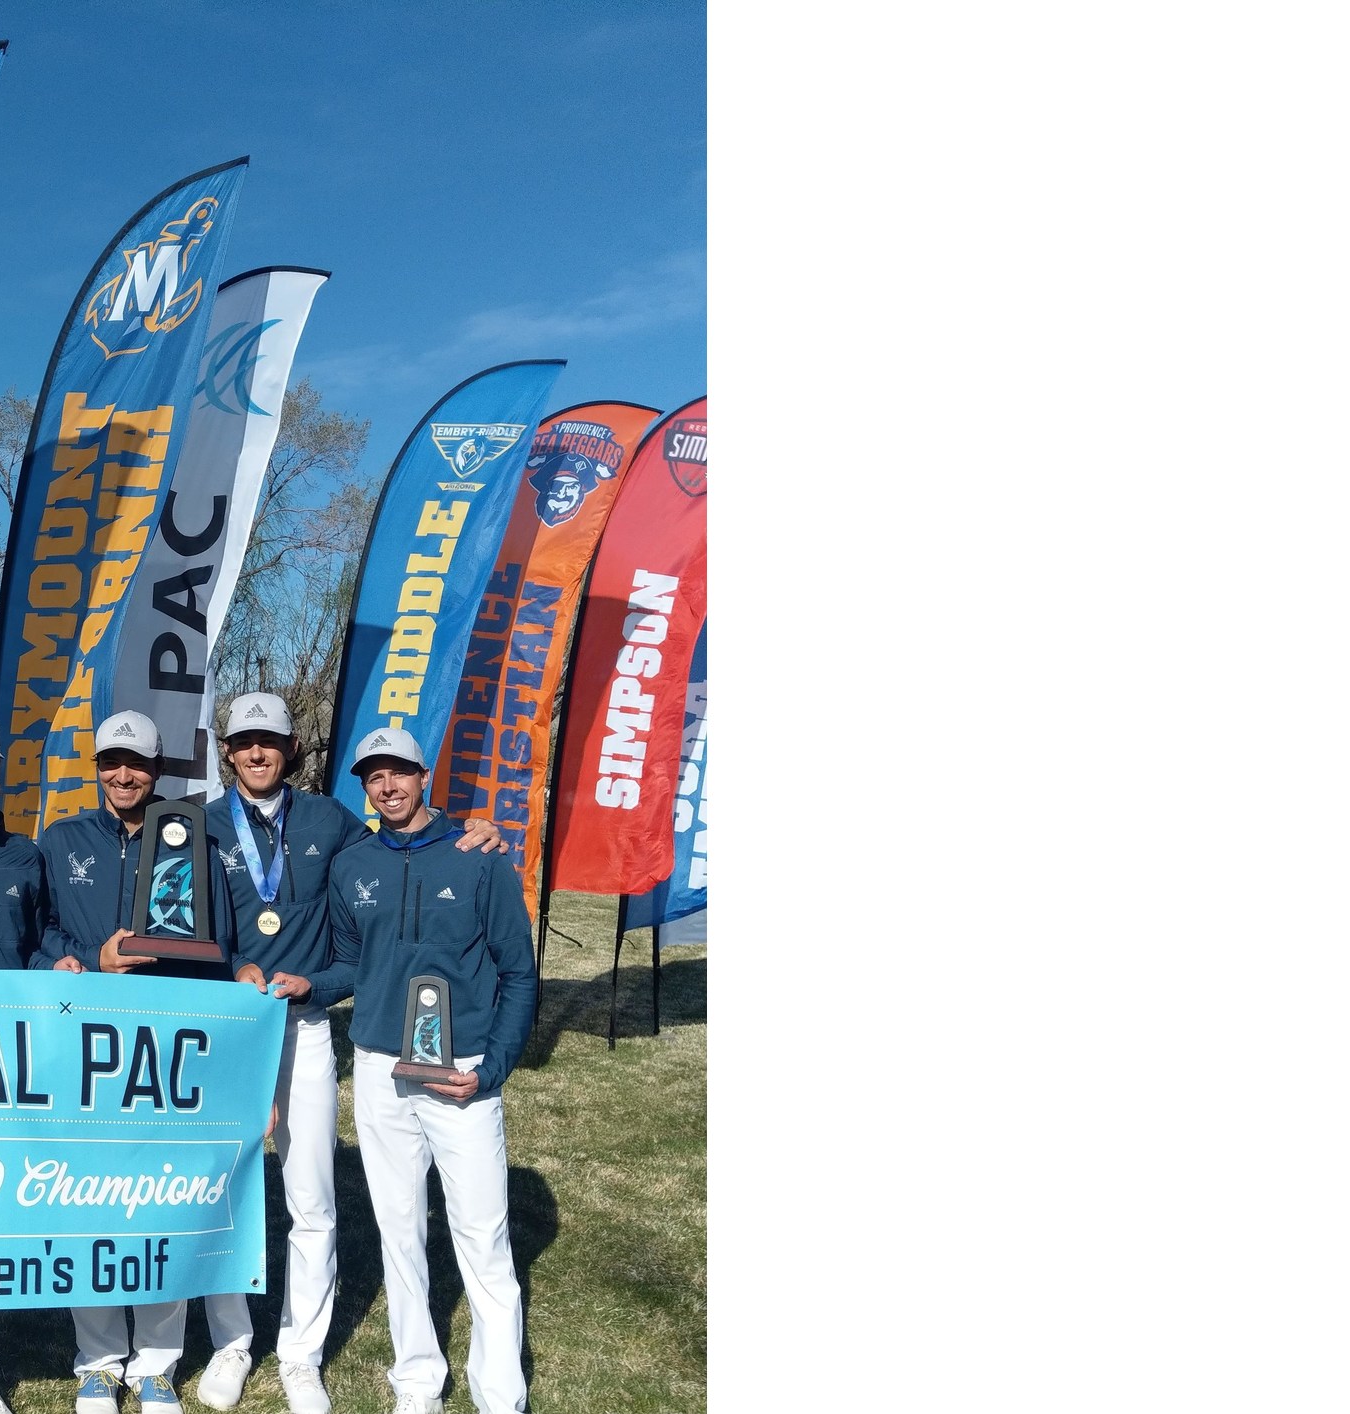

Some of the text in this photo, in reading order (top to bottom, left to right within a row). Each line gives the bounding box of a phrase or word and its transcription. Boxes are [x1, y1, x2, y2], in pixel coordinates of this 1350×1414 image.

[558, 422, 608, 439] PROVIDENCE
[559, 433, 622, 468] BEGGARS
[4, 392, 116, 839] ARYMOUNT
[150, 490, 227, 694] PAC
[244, 711, 268, 719] adidas
[450, 562, 521, 818] VIDENCE
[595, 569, 679, 810] SIMPSON
[112, 727, 136, 738] adidas
[368, 741, 392, 751] adidas
[79, 1022, 211, 1114] PAC
[15, 1156, 228, 1220] Champions
[91, 1238, 169, 1293] Golf
